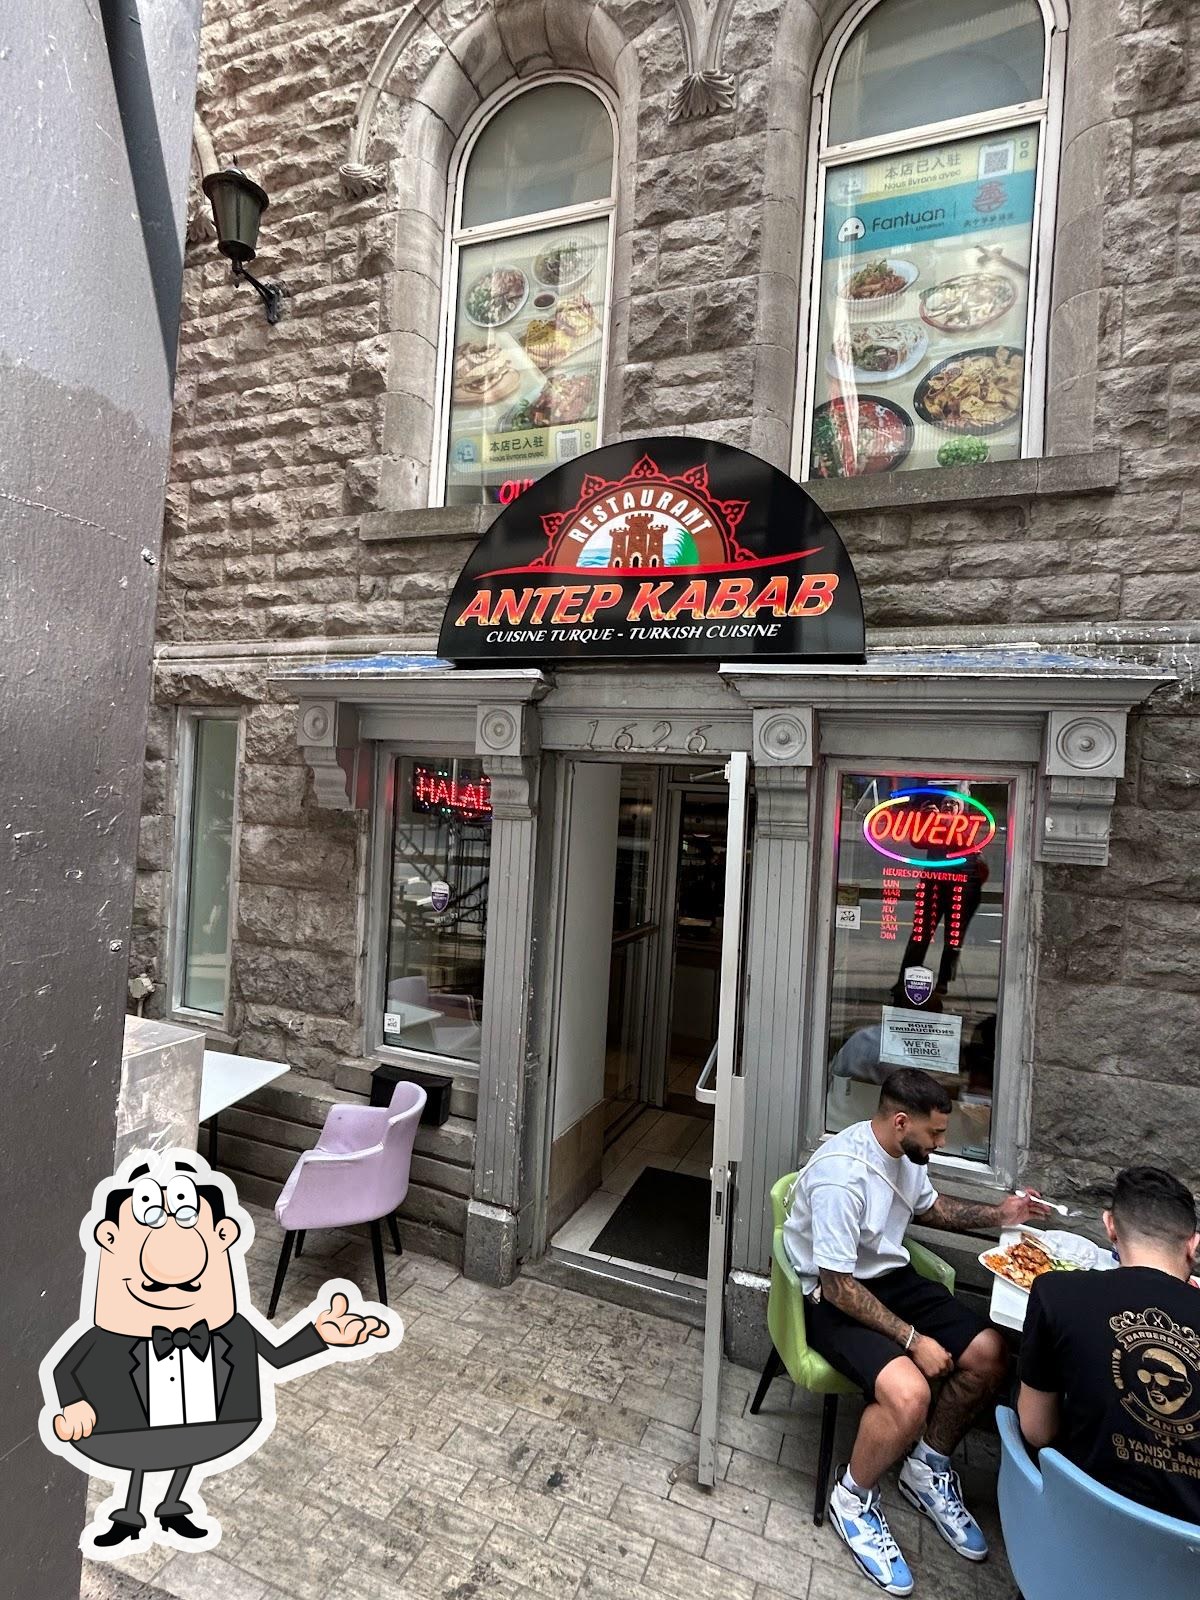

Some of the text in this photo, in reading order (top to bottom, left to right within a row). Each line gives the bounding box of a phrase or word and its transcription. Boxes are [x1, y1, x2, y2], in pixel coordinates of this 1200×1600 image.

[884, 151, 960, 179] 本店已入驻
[884, 169, 961, 191] Nous livrons avec
[872, 208, 945, 232] Fantuan
[490, 435, 544, 452] 本店已入驻
[568, 489, 712, 543] RESTAURANT
[455, 573, 840, 627] ANTEP KABAB
[486, 629, 548, 643] CUISINE
[550, 628, 615, 643] TURQUE
[629, 625, 704, 640] TURKISH
[705, 624, 782, 638] CUISINE
[584, 720, 713, 753] 1626
[419, 776, 492, 811] HALAL
[870, 809, 987, 847] OUVERT
[882, 867, 968, 882] HEURES D'OUVERTURE
[882, 879, 900, 888] LUN
[882, 897, 898, 905] MER
[883, 889, 901, 897] MAR
[882, 905, 894, 913] JEU
[882, 914, 897, 922] VEN
[880, 923, 898, 931] SAM
[880, 931, 896, 939] DIM
[903, 1040, 939, 1049] WE'RE
[903, 1047, 940, 1056] HIRING!
[1125, 1331, 1198, 1360] BARBERSHOP
[1146, 1414, 1194, 1434] YANISO
